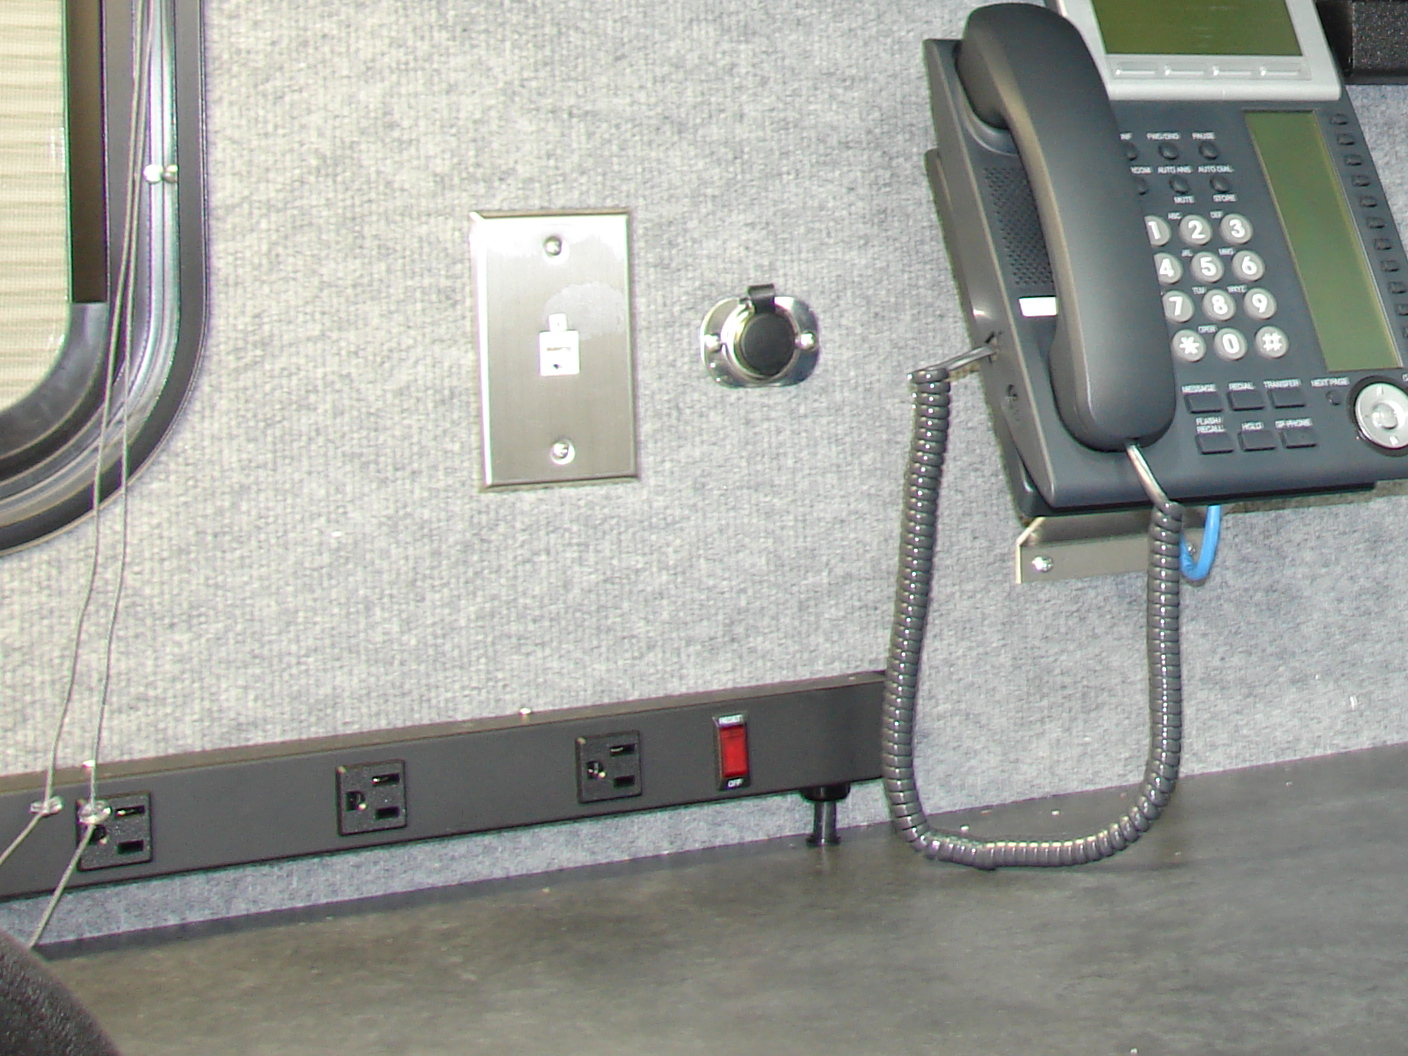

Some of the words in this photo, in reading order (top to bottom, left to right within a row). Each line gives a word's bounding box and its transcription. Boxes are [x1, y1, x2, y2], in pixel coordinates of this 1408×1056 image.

[1191, 131, 1216, 141] PAUSE
[1157, 166, 1175, 174] AUTO
[1197, 166, 1215, 174] AUTO
[1173, 195, 1195, 205] MUTE
[1212, 193, 1237, 203] STORE
[1147, 220, 1162, 240] 1
[1188, 219, 1206, 240] 2
[1229, 218, 1246, 239] 3
[1159, 257, 1175, 278] 4
[1200, 256, 1217, 277] 5
[1241, 255, 1258, 276] 6
[1168, 296, 1184, 317] 7
[1211, 294, 1229, 315] 8
[1252, 293, 1268, 314] 9
[1221, 333, 1240, 354] 0
[1228, 381, 1257, 392] REDIAL
[1263, 378, 1302, 389] TRANSFER
[1310, 379, 1330, 388] NEXT
[1330, 377, 1350, 387] PAGE
[1181, 384, 1218, 394] MESSAGE
[1196, 425, 1227, 434] RECALL
[1241, 421, 1265, 431] HOLD
